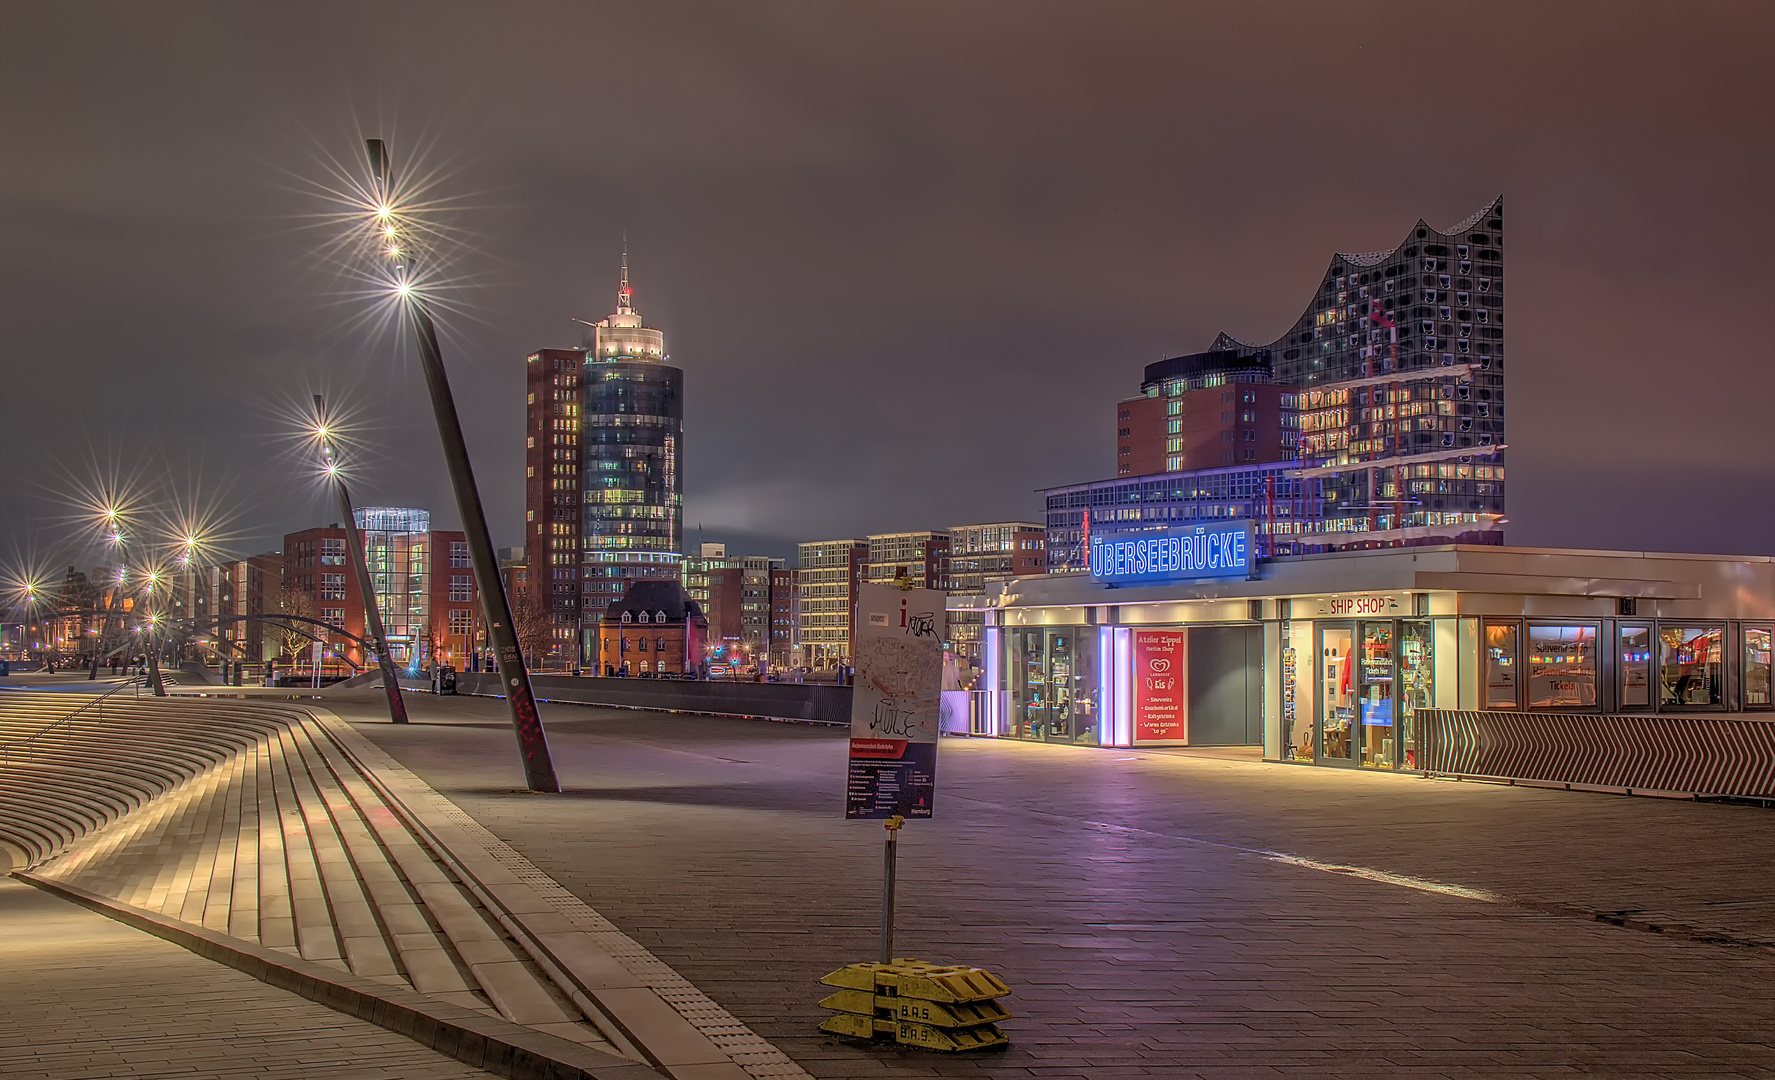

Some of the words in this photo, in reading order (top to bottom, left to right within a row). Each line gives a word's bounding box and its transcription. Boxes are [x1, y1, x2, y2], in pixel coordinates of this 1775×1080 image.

[1092, 527, 1246, 576] ÜBERSEEBRÜCKE
[1330, 599, 1353, 614] SHIP
[1356, 598, 1385, 613] SHOP
[1138, 636, 1159, 644] Atelier
[1161, 636, 1181, 646] Zippel
[1535, 643, 1568, 653] Souvenir
[1154, 679, 1166, 689] Eis
[1549, 680, 1576, 691] Tickets
[911, 808, 931, 816] Hamburg
[902, 1005, 932, 1020] B.A.S.
[901, 1027, 930, 1042] B.A.S.
